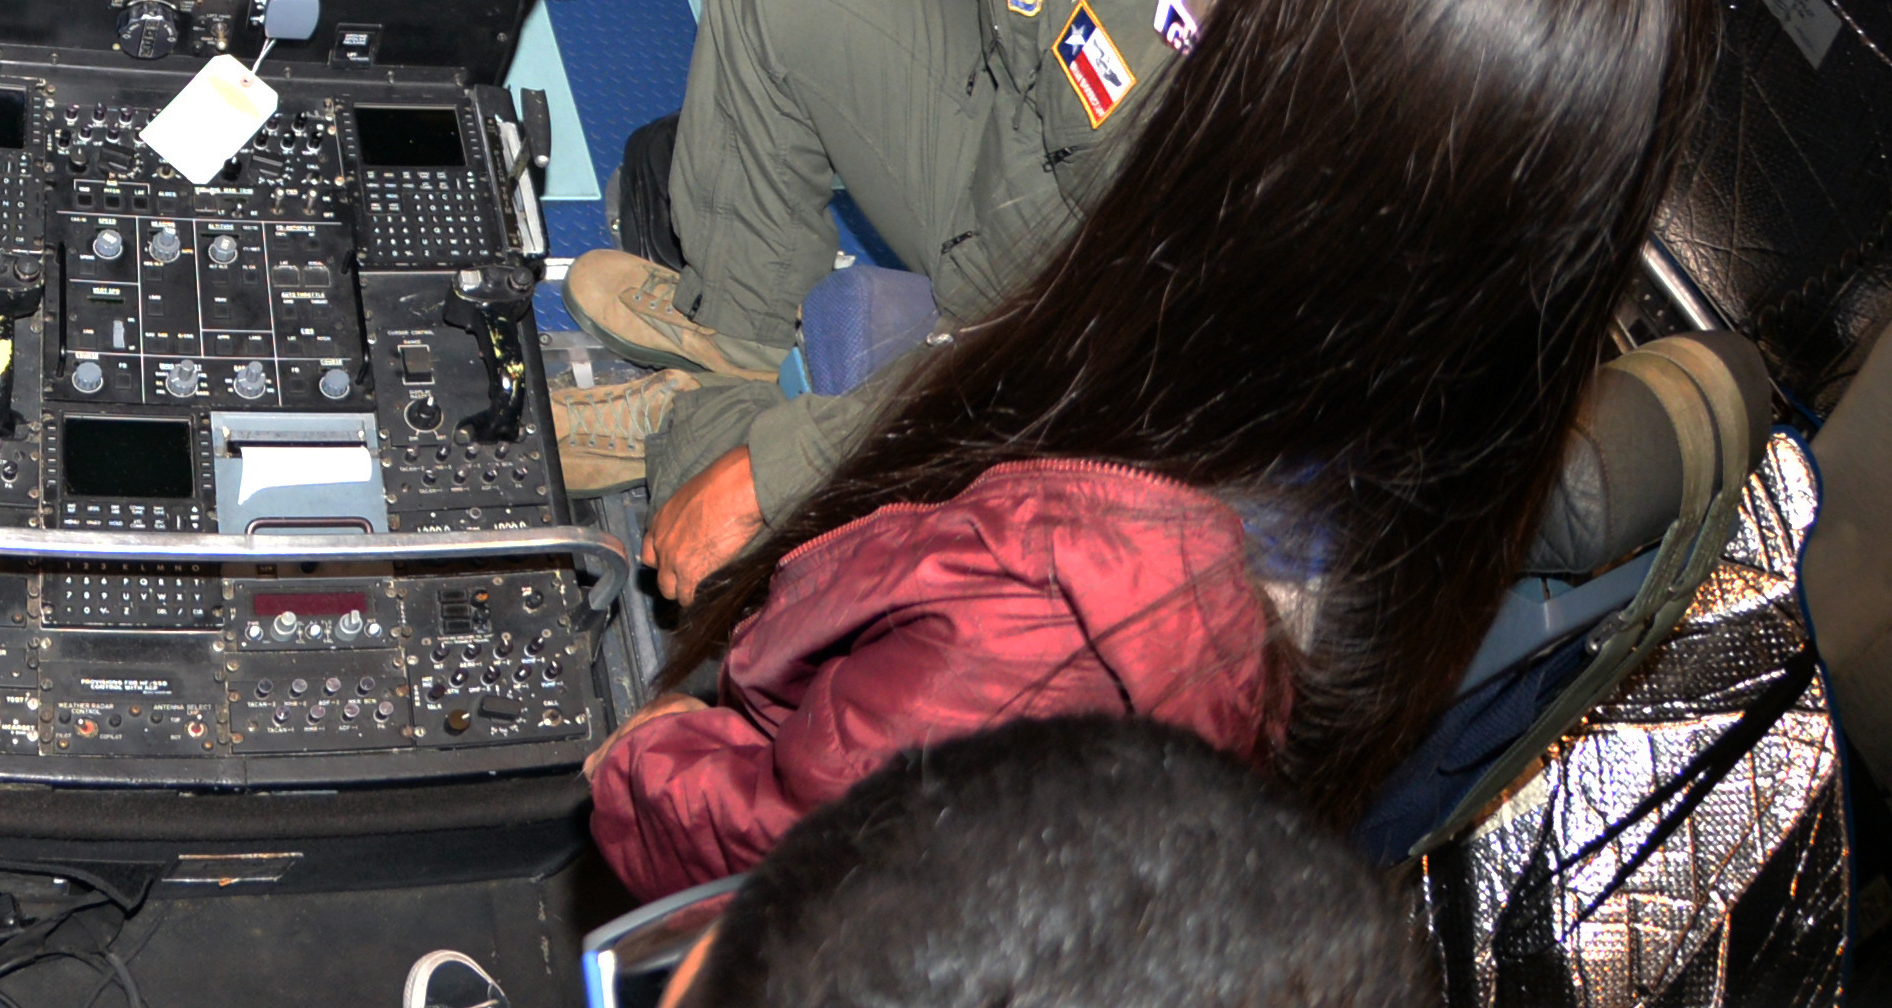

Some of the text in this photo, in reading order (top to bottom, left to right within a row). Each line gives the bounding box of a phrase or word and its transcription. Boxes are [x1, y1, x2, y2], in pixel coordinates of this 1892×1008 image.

[65, 576, 72, 585] 4
[123, 577, 129, 585] P
[139, 578, 148, 586] Q
[66, 591, 73, 599] 7
[101, 592, 108, 600] 9
[122, 592, 130, 600] U
[140, 593, 148, 601] V
[157, 593, 167, 601] W
[91, 702, 115, 710] RADAR
[71, 708, 102, 716] CONTROL
